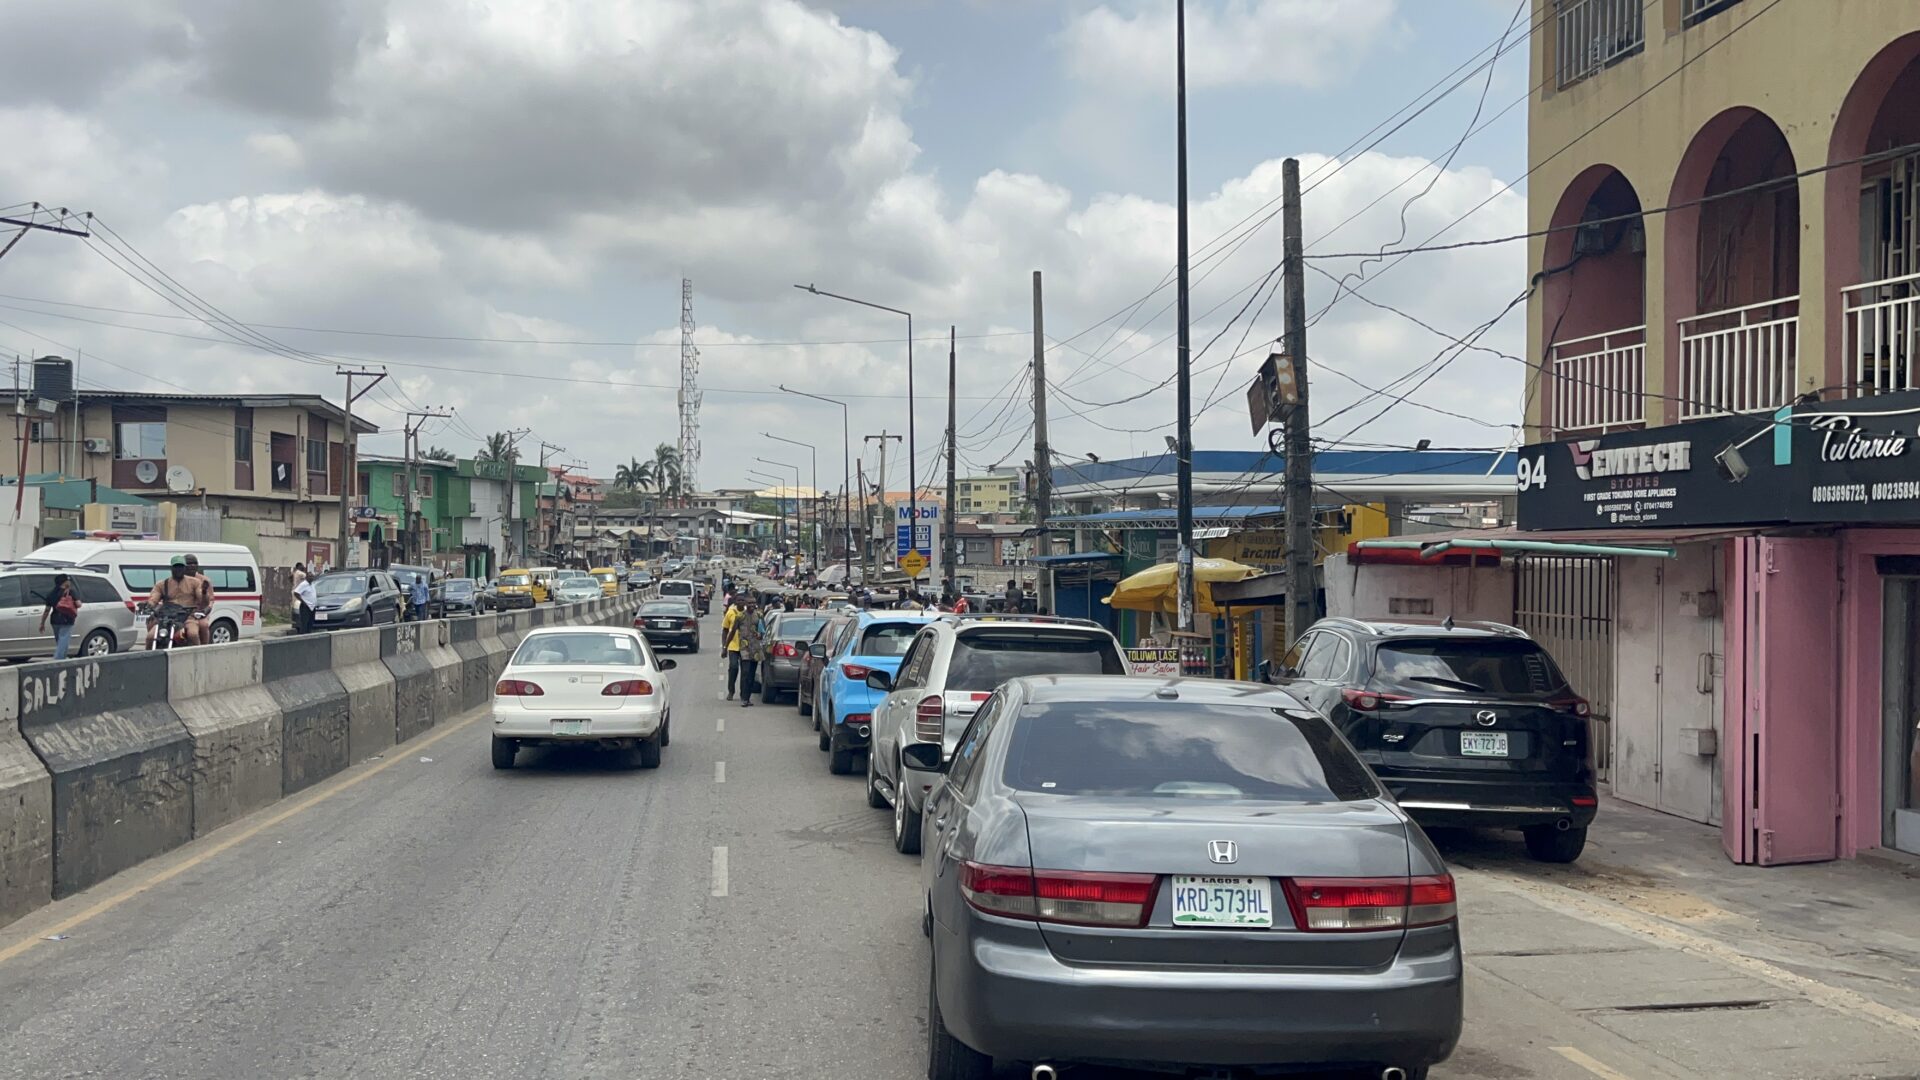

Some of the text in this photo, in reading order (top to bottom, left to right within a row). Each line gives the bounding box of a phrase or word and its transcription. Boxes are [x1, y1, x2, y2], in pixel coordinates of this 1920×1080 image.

[1810, 415, 1906, 461] Twinnie
[1517, 455, 1547, 491] 94
[1610, 476, 1660, 490] STORES
[1647, 487, 1677, 498] APPLIANCES
[899, 507, 937, 519] Mobil
[1127, 650, 1178, 662] TOLUWA LASE
[1152, 661, 1177, 675] Salon
[22, 669, 68, 715] SALE
[1176, 887, 1268, 913] KRD-573HL
